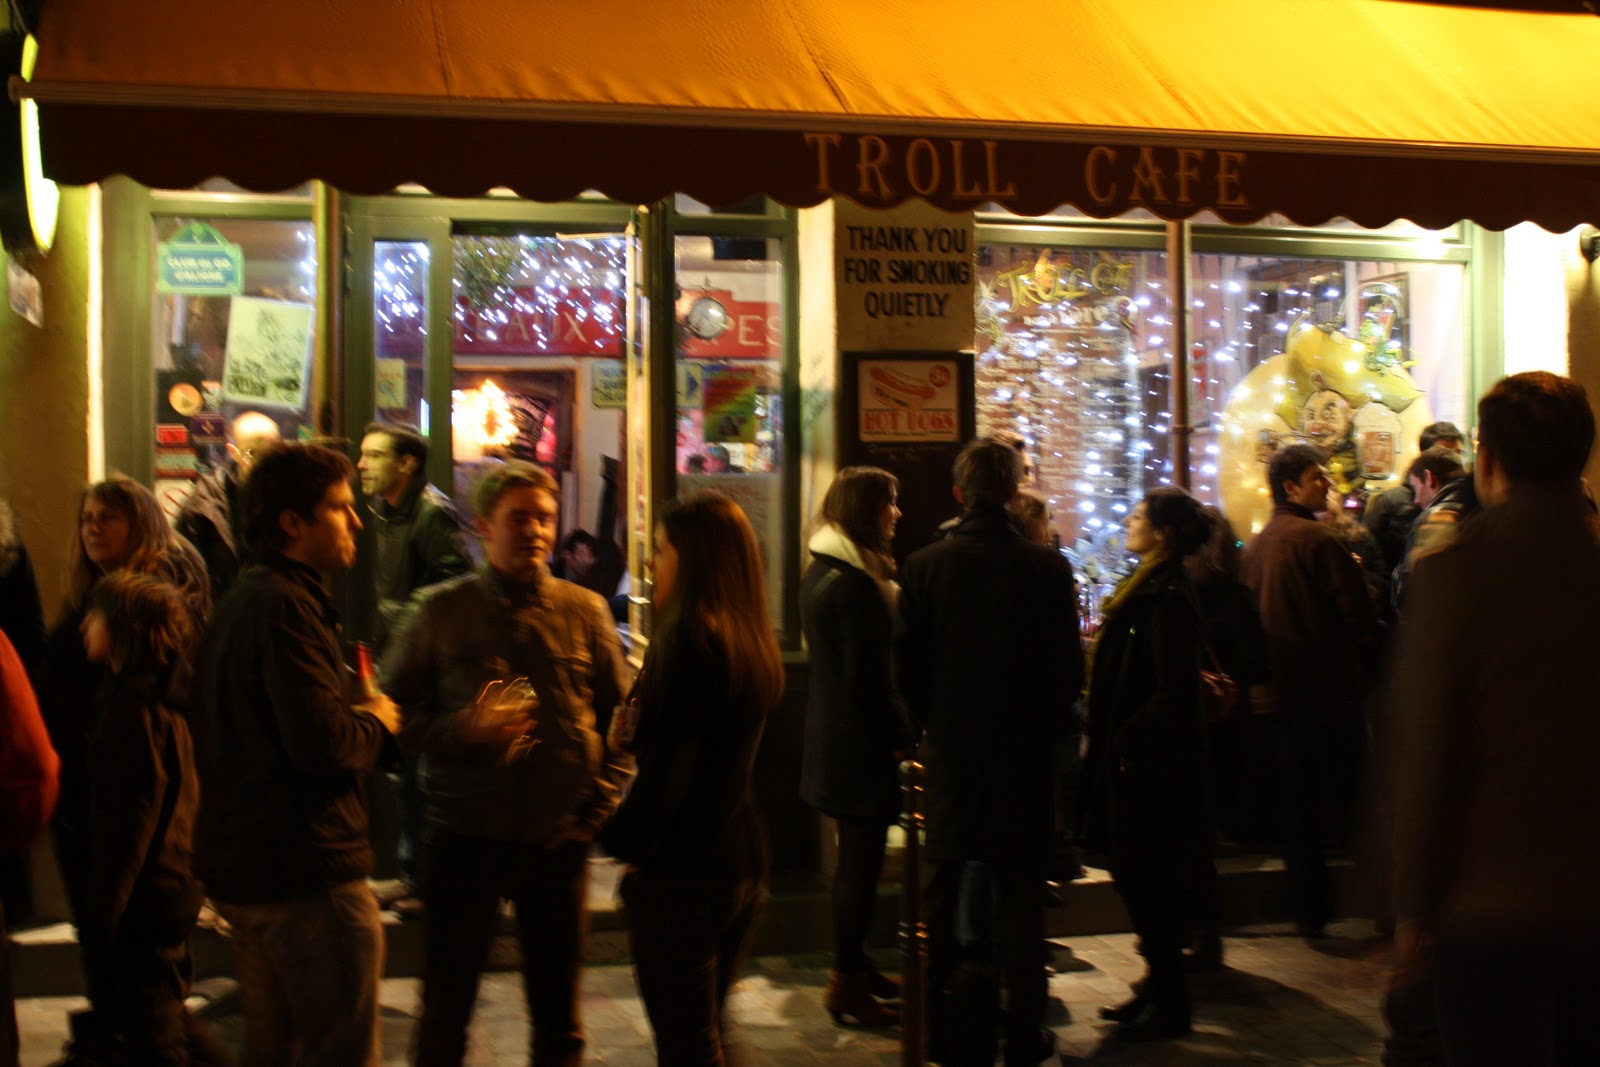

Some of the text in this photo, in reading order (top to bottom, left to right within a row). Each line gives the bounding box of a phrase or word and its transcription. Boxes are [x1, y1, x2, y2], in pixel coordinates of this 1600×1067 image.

[803, 133, 1248, 208] TROLL CAFE
[846, 225, 967, 253] THANK YOU
[844, 258, 970, 285] FOR SMOKING
[864, 291, 950, 319] QUIETLY
[863, 411, 954, 432] HOT DOGS
